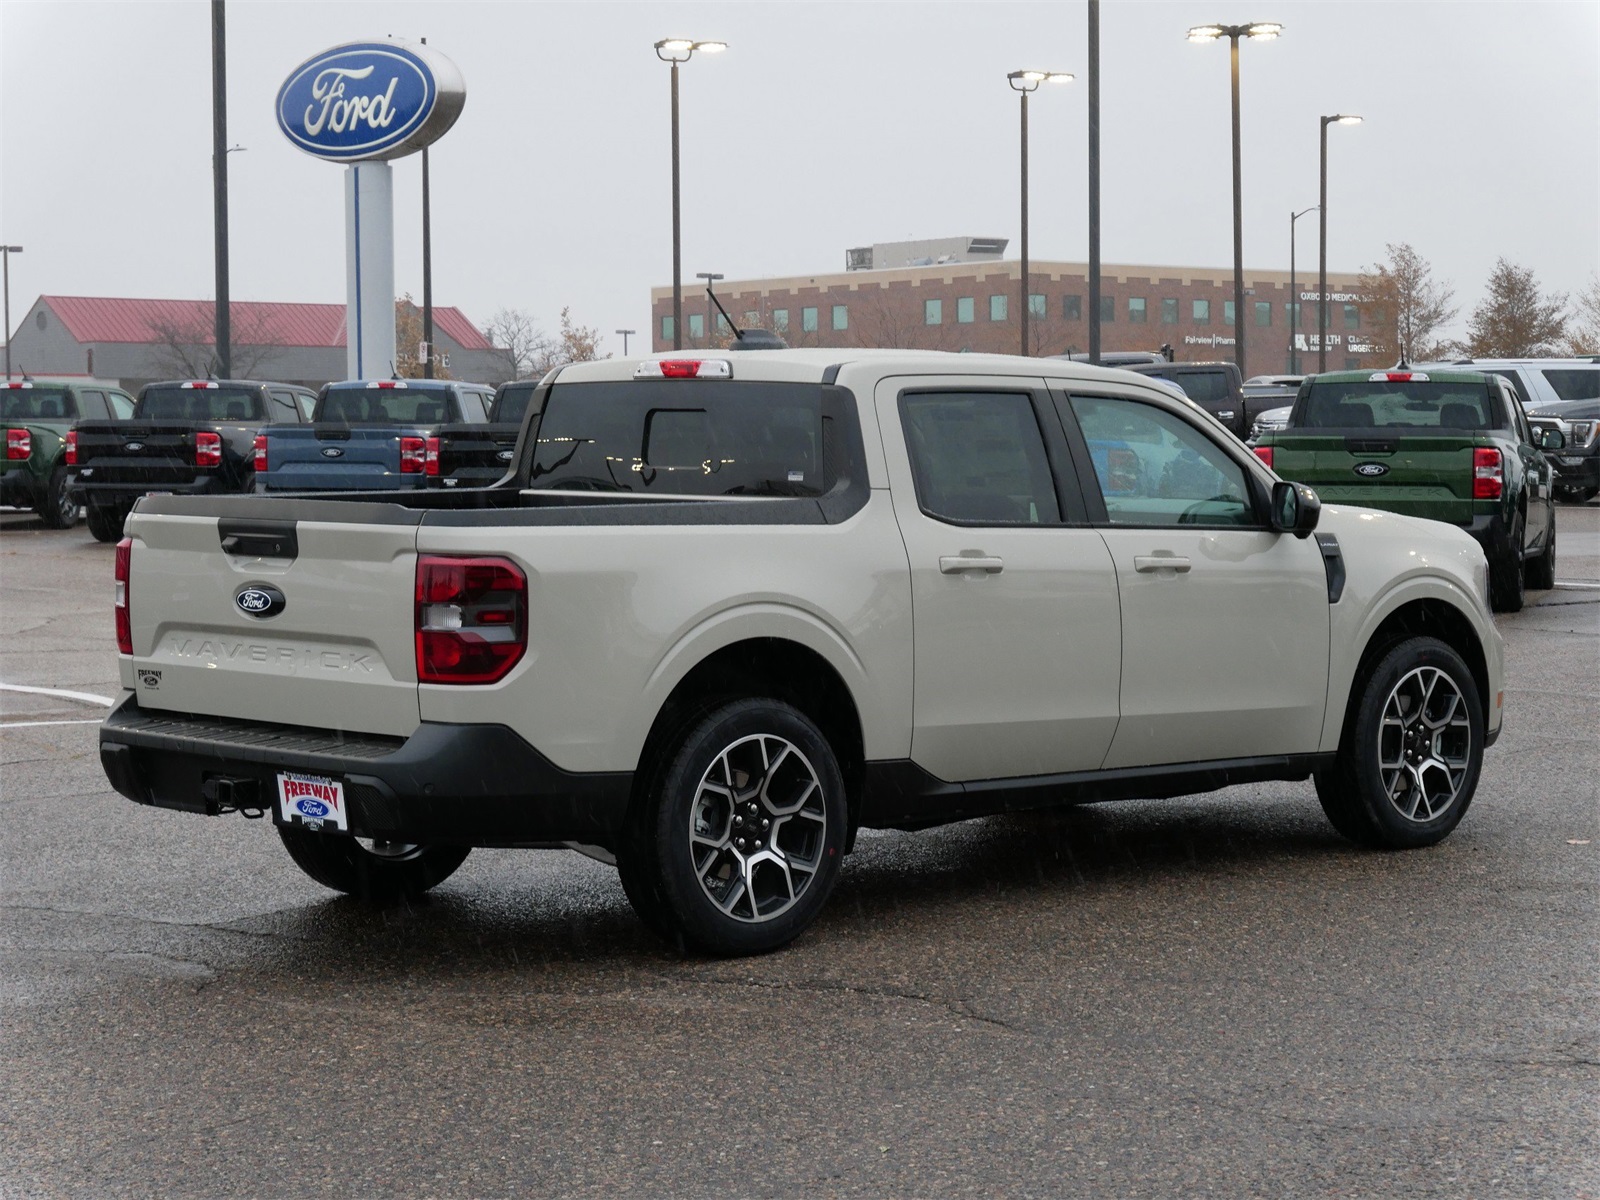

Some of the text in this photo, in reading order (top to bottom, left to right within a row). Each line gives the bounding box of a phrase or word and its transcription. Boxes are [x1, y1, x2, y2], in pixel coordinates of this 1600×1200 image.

[304, 65, 399, 136] Ford
[1310, 335, 1341, 344] HELTH
[1321, 487, 1442, 496] AVERICK
[170, 638, 374, 673] MAVERICK
[283, 780, 338, 813] FREEWAY
[302, 800, 323, 815] Ford
